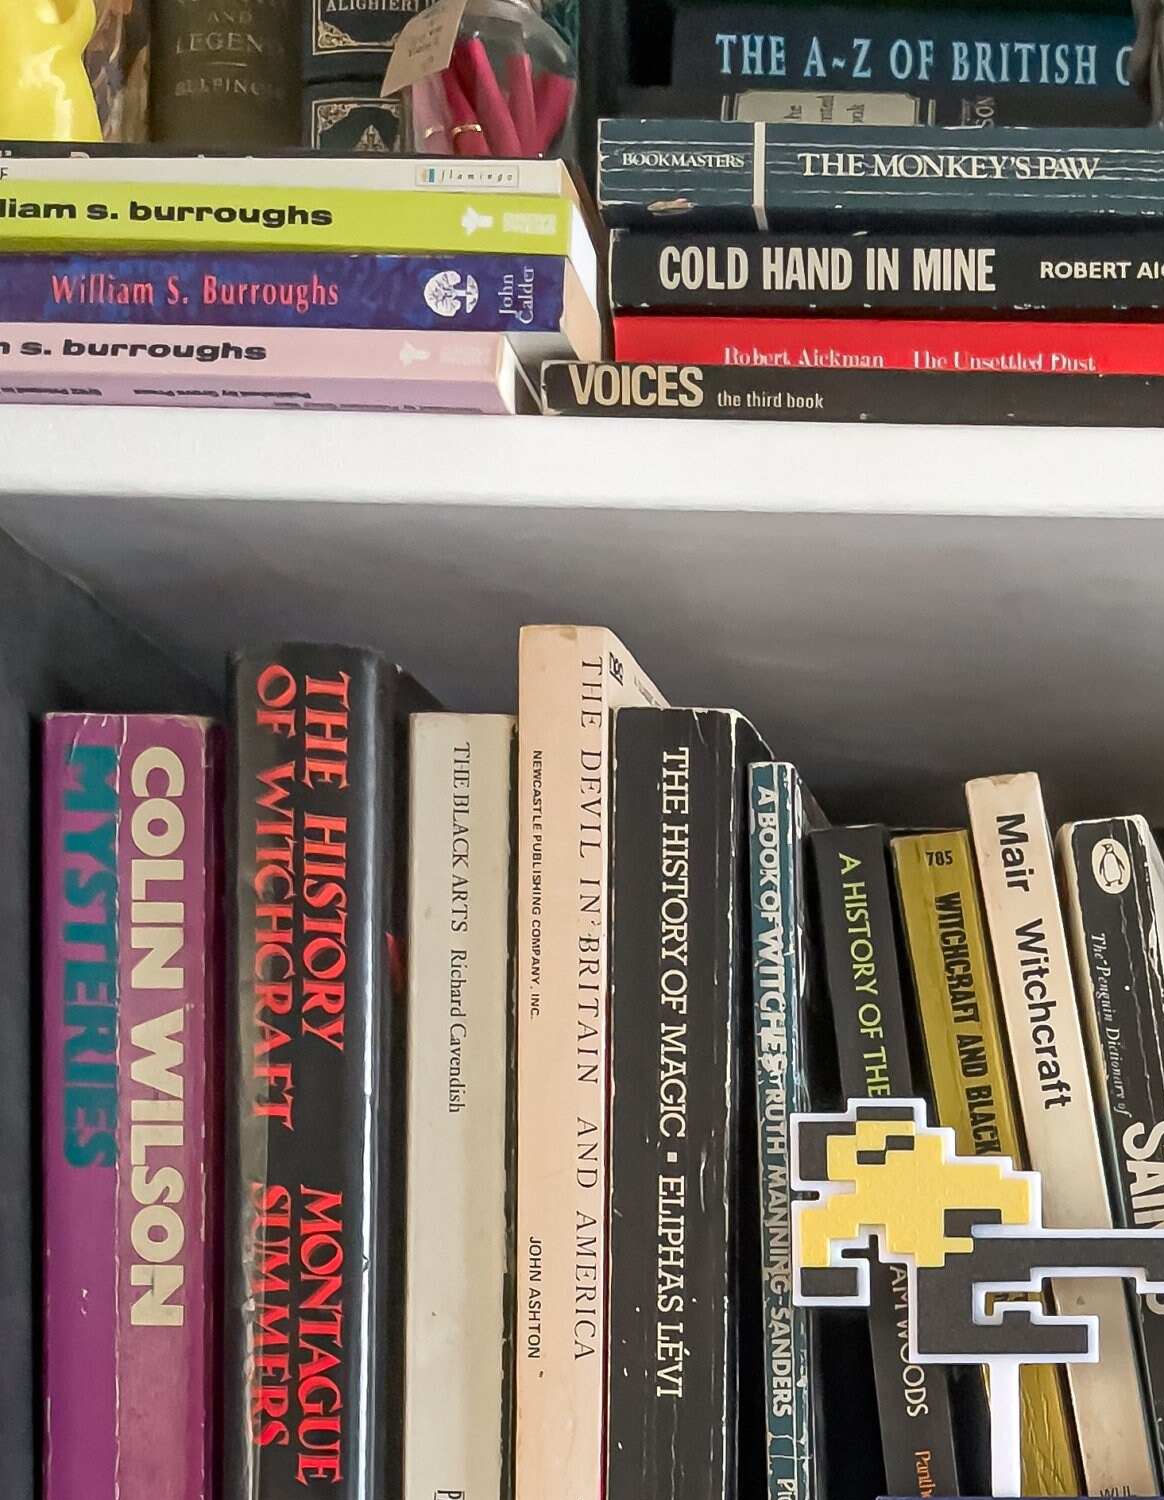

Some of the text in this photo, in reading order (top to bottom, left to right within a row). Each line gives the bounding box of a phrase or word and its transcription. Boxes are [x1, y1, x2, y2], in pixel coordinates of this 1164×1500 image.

[716, 33, 786, 76] THE
[890, 39, 934, 80] OF
[952, 41, 1098, 86] BRITISH
[441, 169, 513, 182] flamingo
[621, 152, 745, 169] BOOKMASTERS
[797, 152, 865, 177] THE
[871, 152, 1030, 181] MONKEY'S
[1037, 156, 1101, 181] PAW
[87, 200, 333, 228] s. burroughs
[51, 272, 339, 313] William S. Burroughs
[498, 273, 517, 315] John
[516, 266, 535, 324] Calder
[659, 246, 748, 292] COLD
[762, 247, 852, 292] HAND
[866, 247, 899, 292] IN
[913, 247, 996, 292] MINE
[1040, 261, 1131, 280] ROBERT
[63, 339, 267, 361] burroughs
[569, 365, 824, 410] VOICES the third book
[723, 346, 1097, 371] Robert Aickman The Unsettled Dust
[531, 750, 542, 830] NEWCASTLE
[302, 671, 352, 1053] THE HISTORY
[531, 834, 542, 916] PUBLISHING
[758, 812, 779, 885] BOOK
[925, 850, 954, 867] 785
[251, 664, 297, 1131] OF WITCHCRAFT
[447, 741, 472, 1113] THE BLACK ARTS Richard Cavendish
[759, 890, 780, 922] OF
[63, 744, 118, 1168] MYSTERIES
[838, 852, 891, 1098] A HISTORY OF THE
[995, 813, 1072, 1110] Mair Witchcraft
[130, 746, 185, 1327] COLIN WILSON
[529, 993, 540, 1020] INC.
[574, 656, 603, 1362] THE DEVIL IN BRITAIN AND AMERICA
[934, 891, 1000, 1155] WITCHCRAFT AND BLACK
[1093, 961, 1112, 1019] Penguin
[1105, 1024, 1127, 1098] Dictionary
[656, 746, 691, 1398] THE HISTORY OF MAGIC ELIPHAS LÉVI
[765, 1088, 787, 1154] RUTH
[250, 1181, 292, 1448] SUMMERS
[295, 1183, 344, 1487] MONTAGUE
[527, 1236, 542, 1358] JOHN ASHTON
